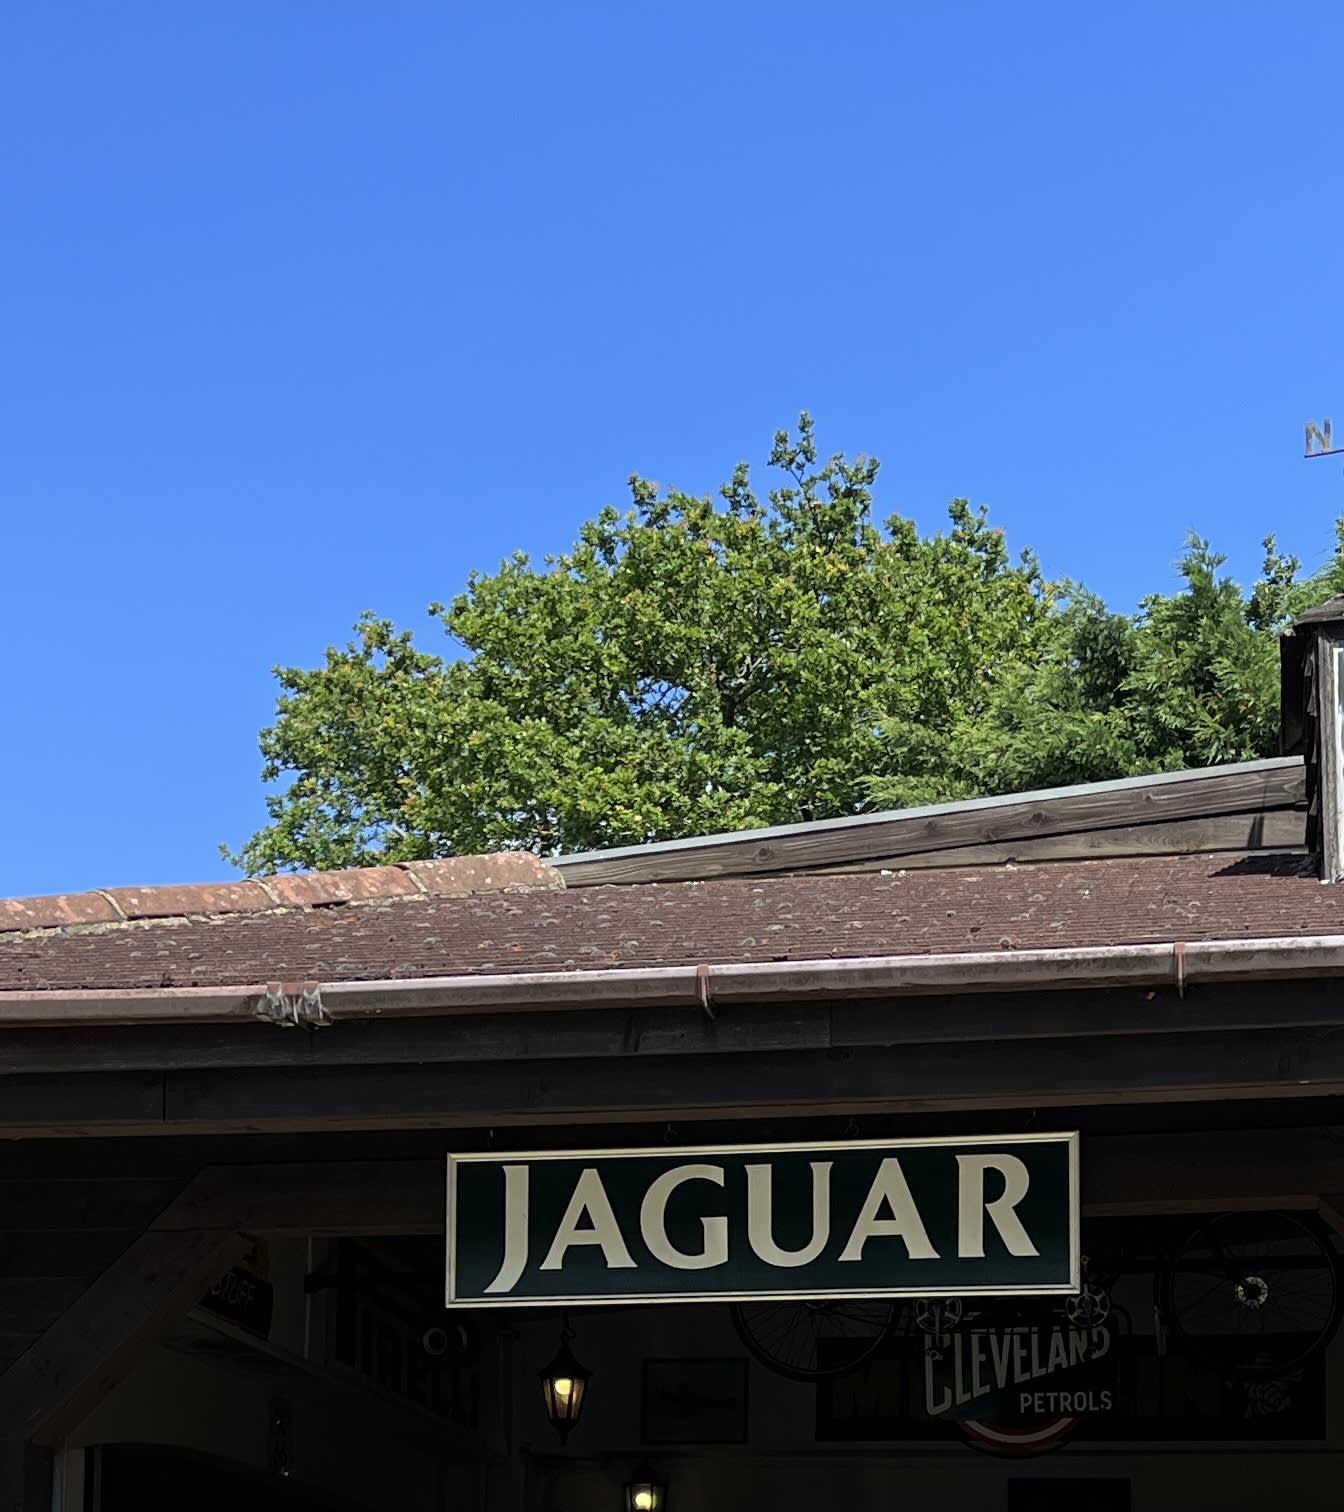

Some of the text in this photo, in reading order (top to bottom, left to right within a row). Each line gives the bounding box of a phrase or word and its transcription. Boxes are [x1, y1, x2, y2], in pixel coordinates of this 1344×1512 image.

[483, 1153, 1041, 1294] JAGUAR
[924, 1326, 1110, 1416] CLEVELAND
[1020, 1391, 1113, 1414] PETROLS
